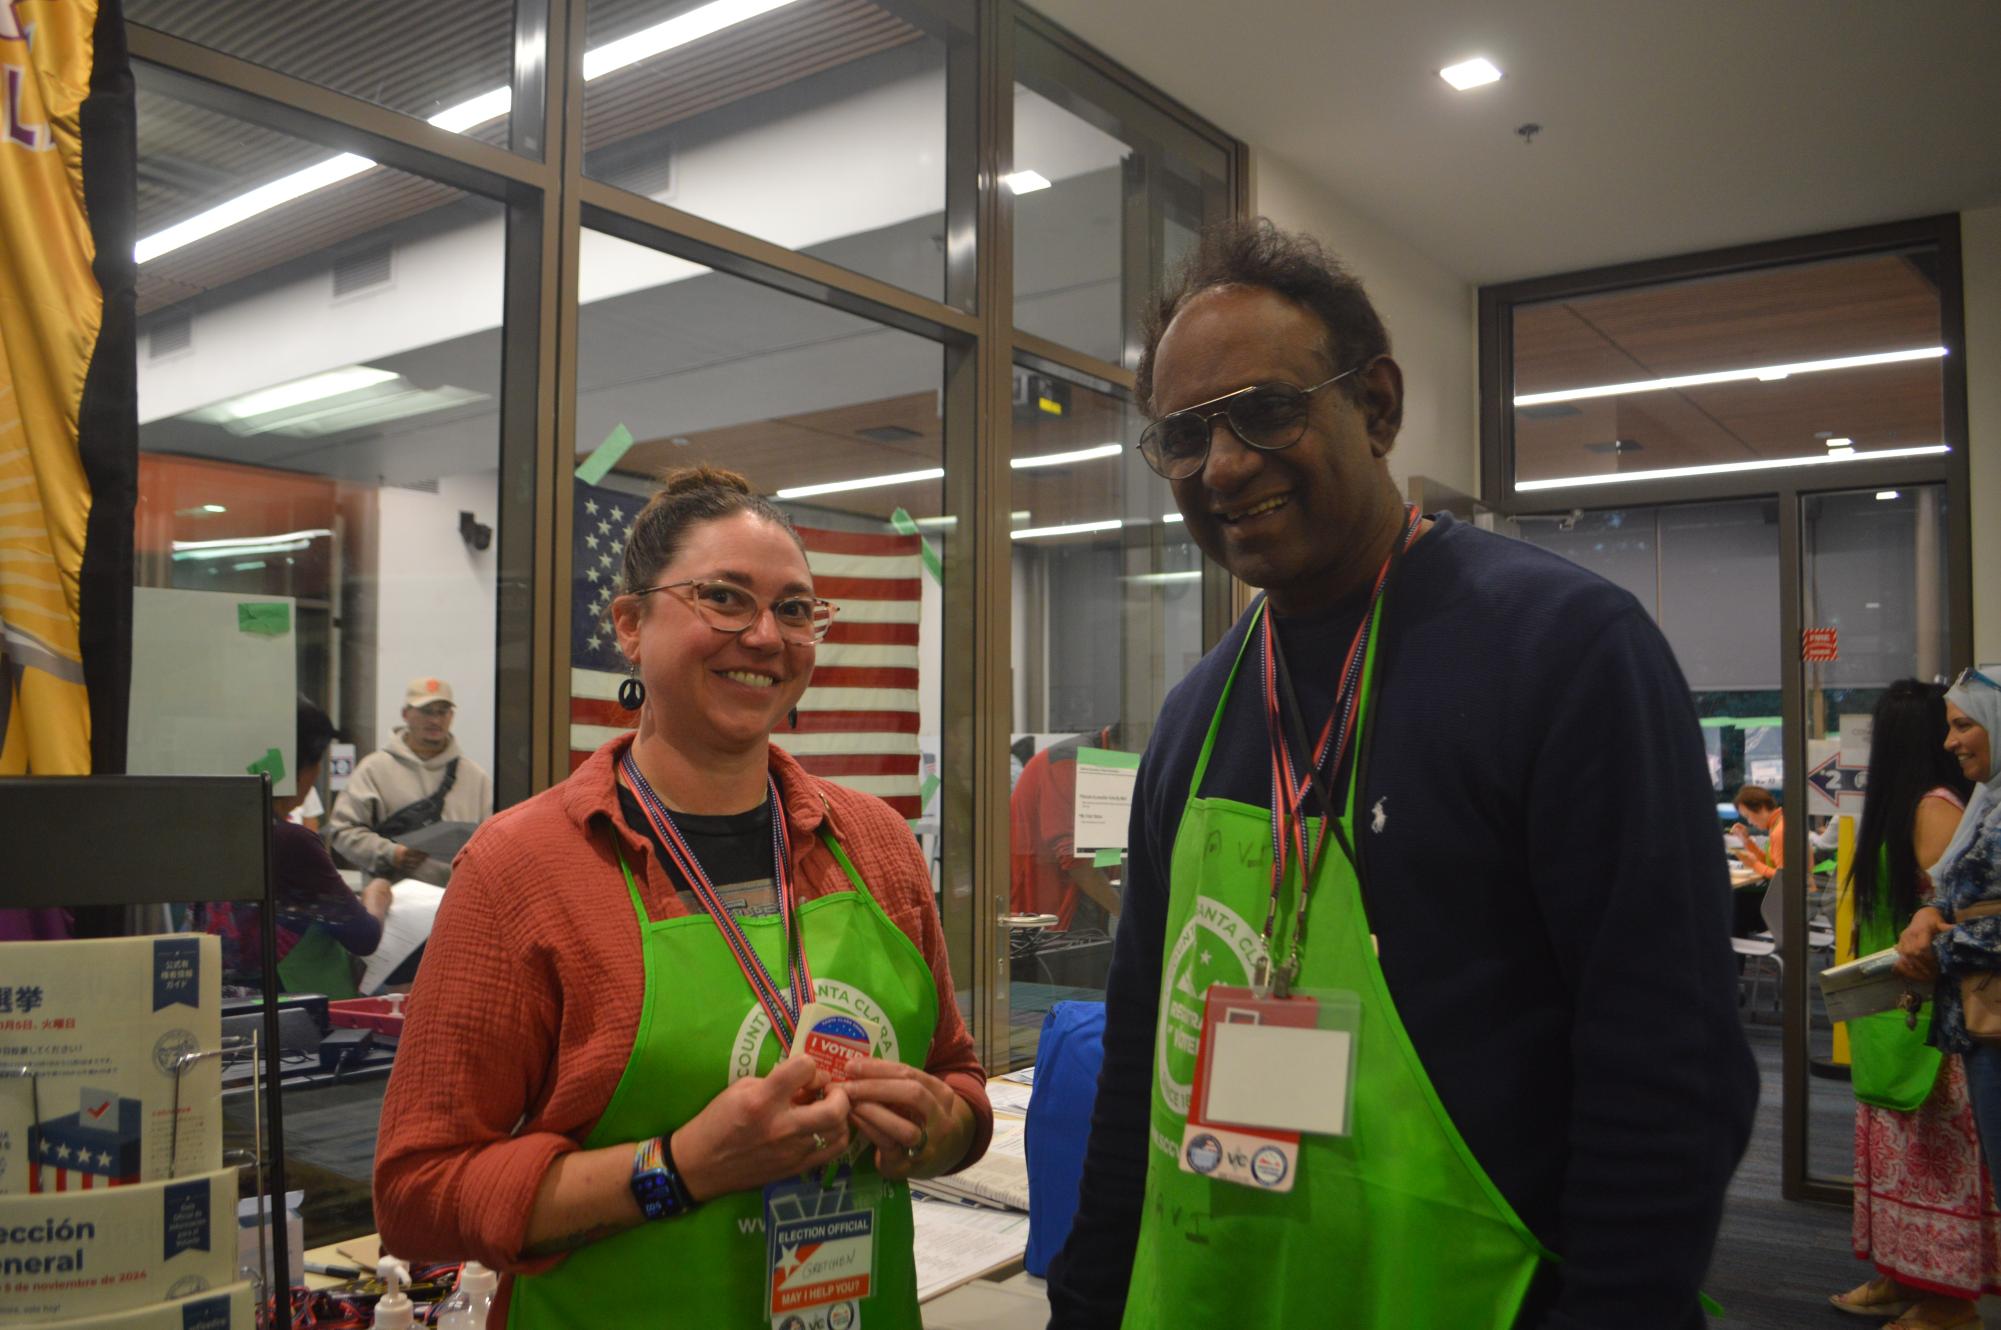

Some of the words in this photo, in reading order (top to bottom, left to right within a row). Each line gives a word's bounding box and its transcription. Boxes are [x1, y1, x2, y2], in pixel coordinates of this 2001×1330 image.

[778, 1226, 825, 1243] ELECTION
[827, 1219, 869, 1235] OFFICIAL
[33, 1278, 98, 1291] noviembre
[782, 1291, 801, 1305] MAY
[809, 1284, 834, 1299] HELP
[835, 1280, 860, 1295] YOU?
